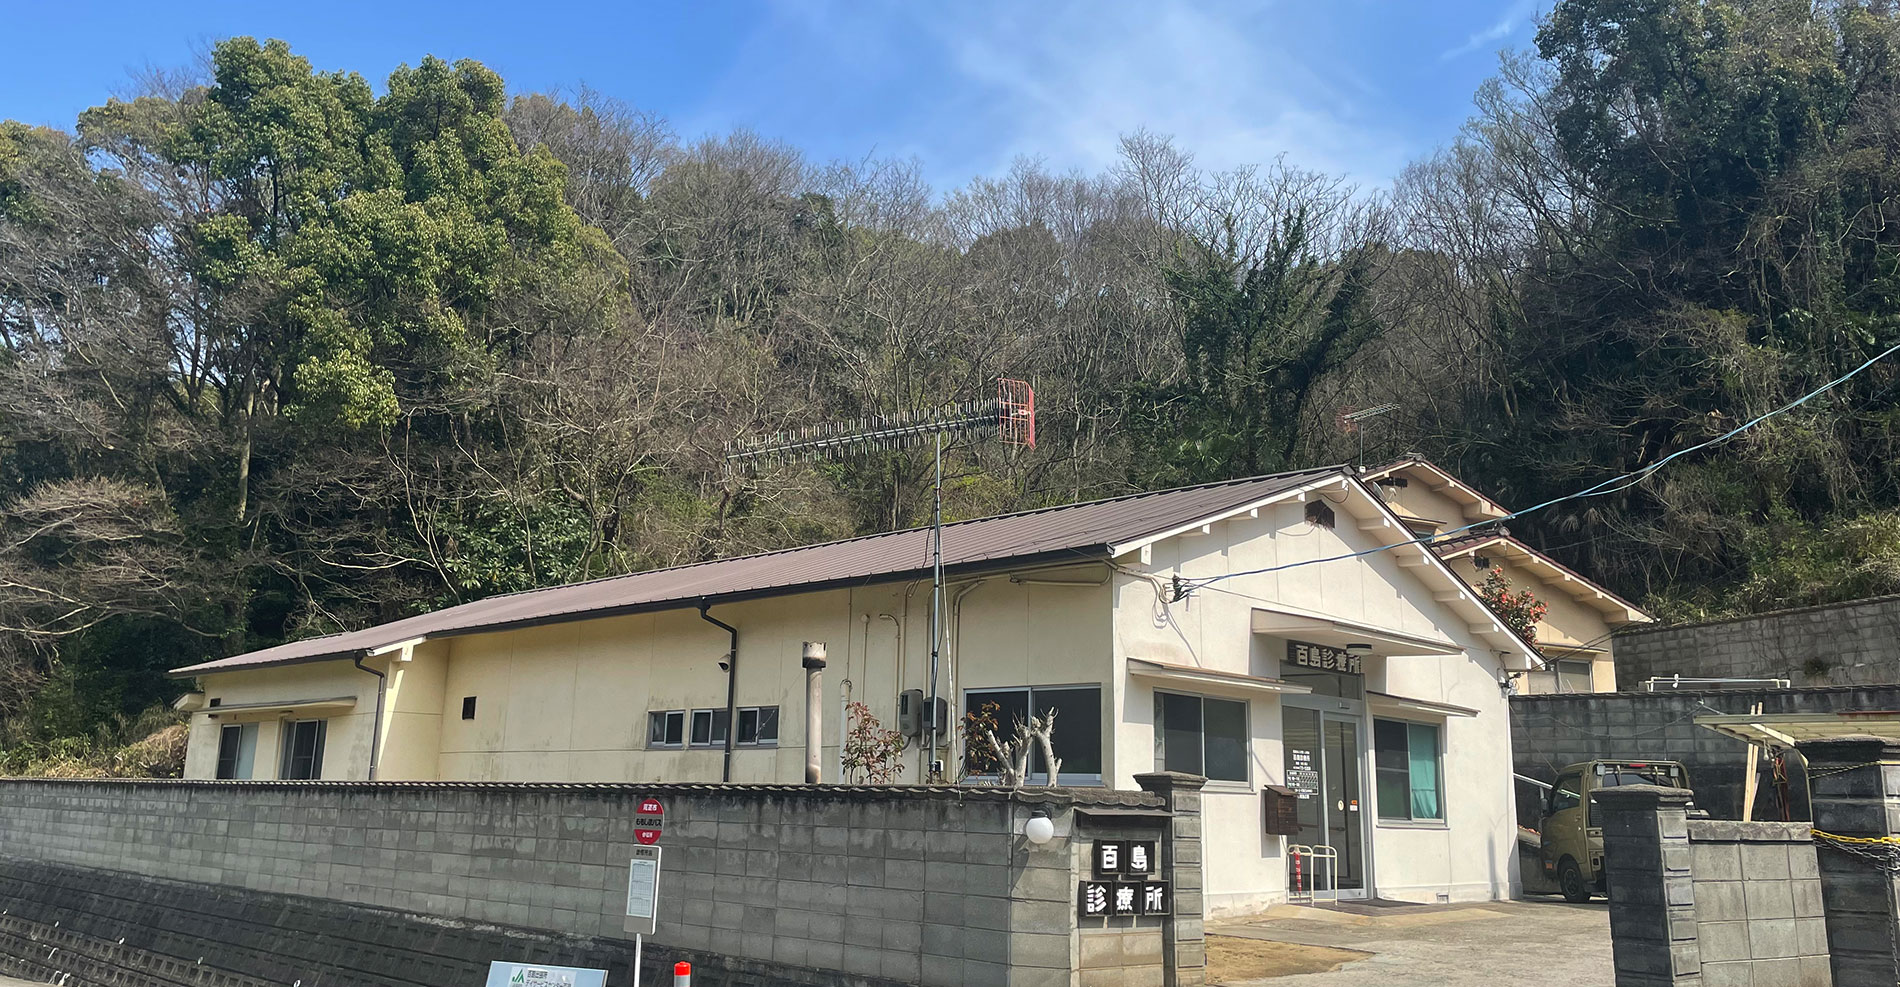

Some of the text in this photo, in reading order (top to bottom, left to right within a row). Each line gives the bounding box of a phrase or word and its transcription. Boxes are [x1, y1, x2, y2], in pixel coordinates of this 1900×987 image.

[1296, 645, 1361, 674] 百島診療所
[1101, 844, 1147, 871] 百島
[1087, 884, 1162, 912] 診療所
